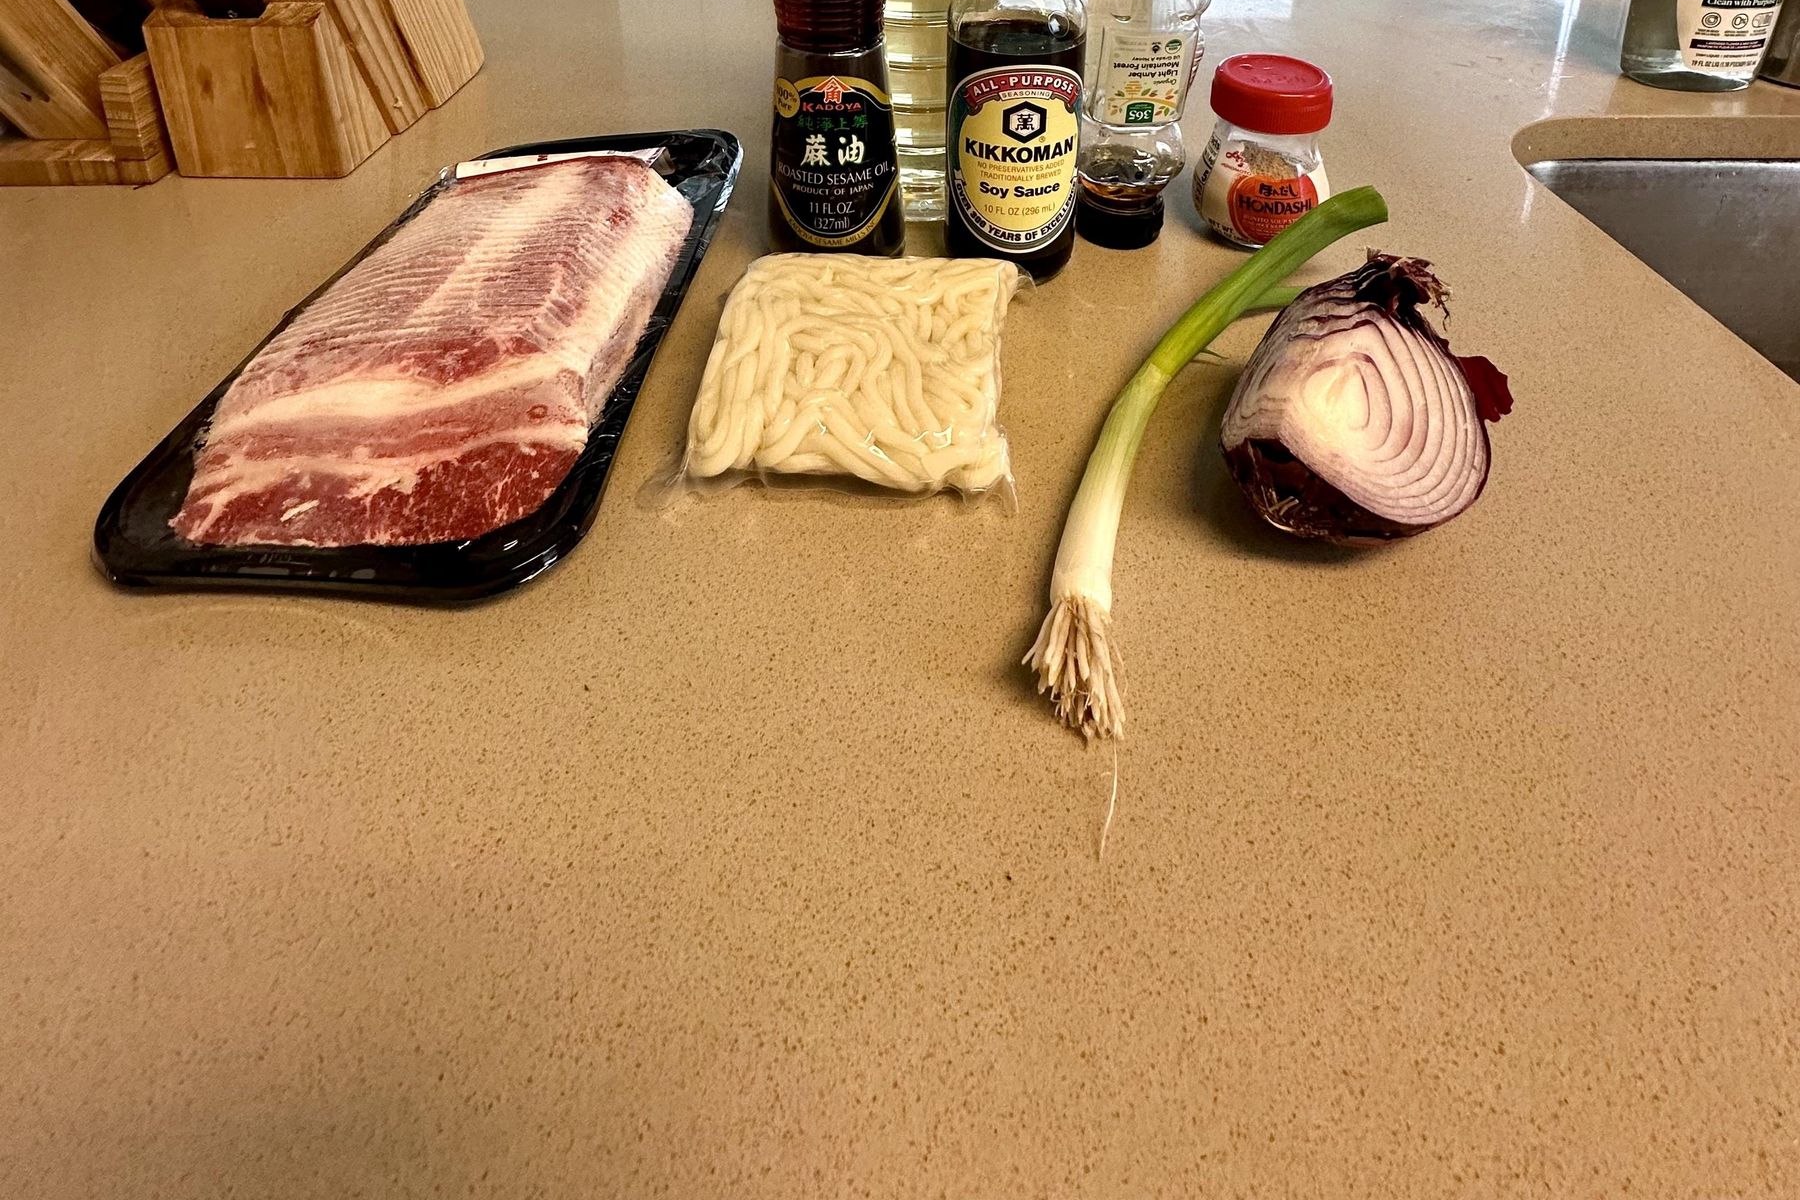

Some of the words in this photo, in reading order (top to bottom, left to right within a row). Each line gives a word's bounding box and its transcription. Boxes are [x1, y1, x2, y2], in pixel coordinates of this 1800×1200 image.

[1141, 61, 1180, 70] Mountain
[973, 75, 1074, 96] ALL-PURPOSE
[802, 102, 862, 112] KADOYA
[1128, 110, 1152, 120] 365
[965, 135, 1074, 164] KIKKOMAN
[778, 161, 824, 185] ROASTED
[827, 167, 872, 186] SESAME
[874, 160, 889, 176] OIL
[978, 161, 988, 170] NO
[989, 164, 1044, 174] PRESERVATIVES
[1045, 159, 1065, 170] ADDED
[980, 170, 1034, 182] TRADITIONALLY
[1036, 169, 1061, 180] BREWED
[792, 183, 830, 196] PRODUCT
[850, 182, 874, 195] JAPAN
[980, 181, 1009, 199] Soy
[1014, 182, 1060, 198] Sauce
[1259, 182, 1298, 197] ほんだし
[810, 202, 819, 214] 11
[984, 204, 993, 214] 10
[996, 207, 1006, 215] FL
[1008, 207, 1020, 216] OZ
[1022, 204, 1040, 217] (296
[1042, 203, 1056, 213] mL)
[1238, 194, 1312, 215] HONDASHI
[956, 183, 972, 212] OVER
[970, 210, 987, 228] 300
[988, 224, 1022, 242] YEARS
[1024, 230, 1038, 241] OF
[814, 216, 850, 230] (327ml)
